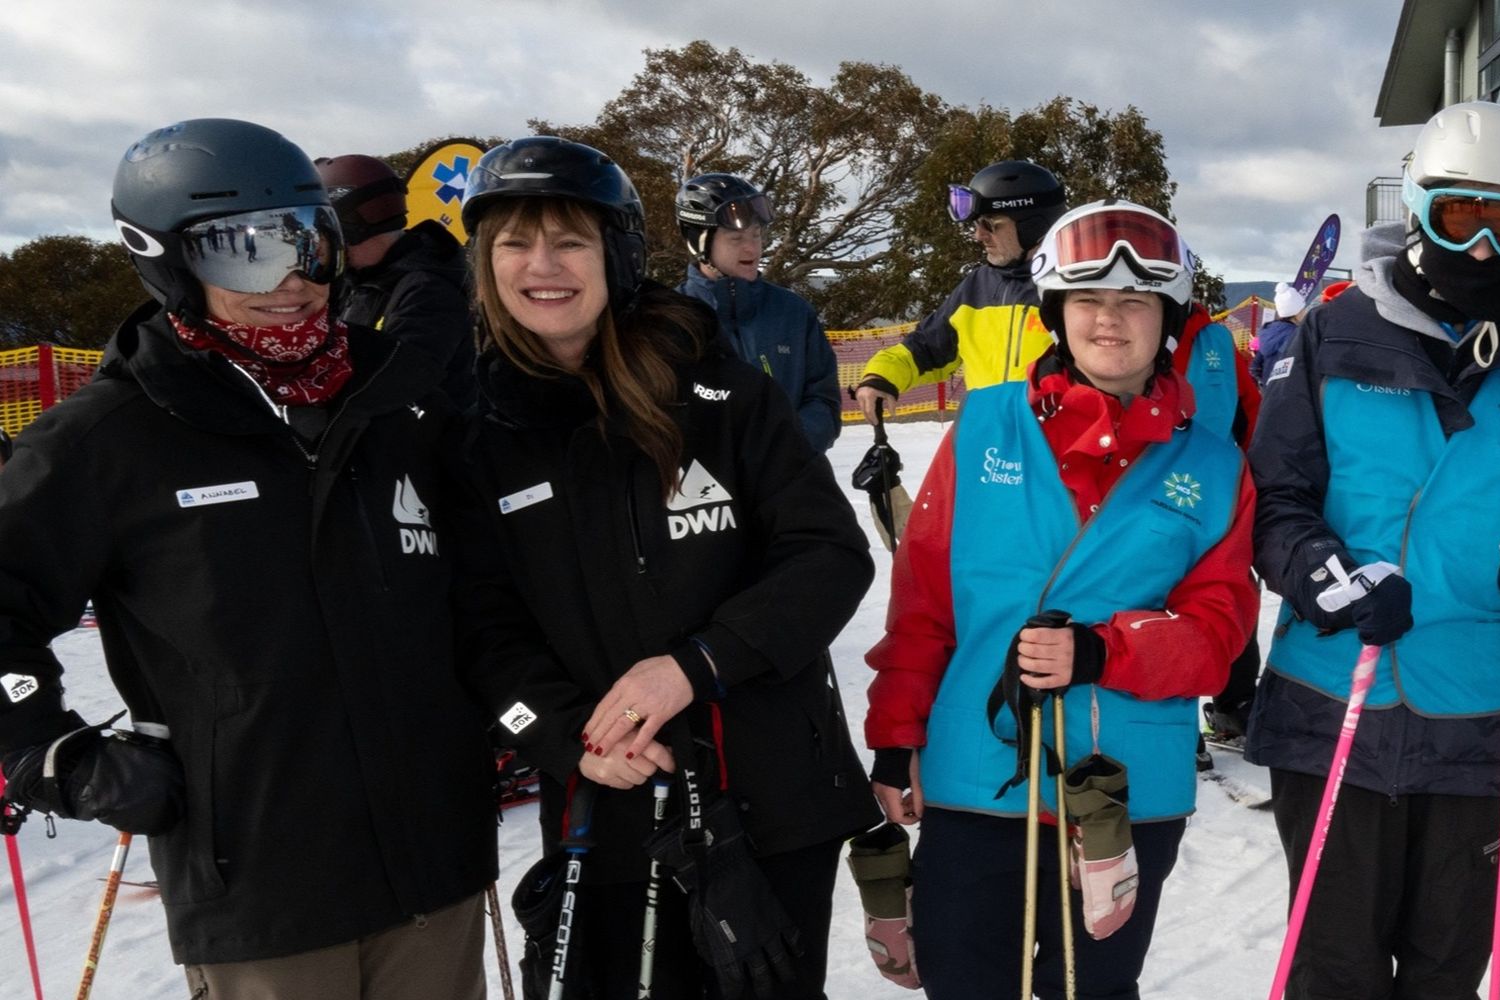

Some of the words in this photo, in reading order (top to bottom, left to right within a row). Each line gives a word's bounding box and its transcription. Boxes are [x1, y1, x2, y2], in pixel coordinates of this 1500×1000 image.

[992, 198, 1034, 209] SMITH
[980, 460, 1024, 486] Sister
[201, 488, 248, 500] ANNABEL
[667, 505, 737, 540] DWA
[11, 681, 36, 699] 30K
[512, 713, 533, 731] 30K
[685, 769, 702, 830] SCOTT
[552, 890, 576, 979] SCOTT
